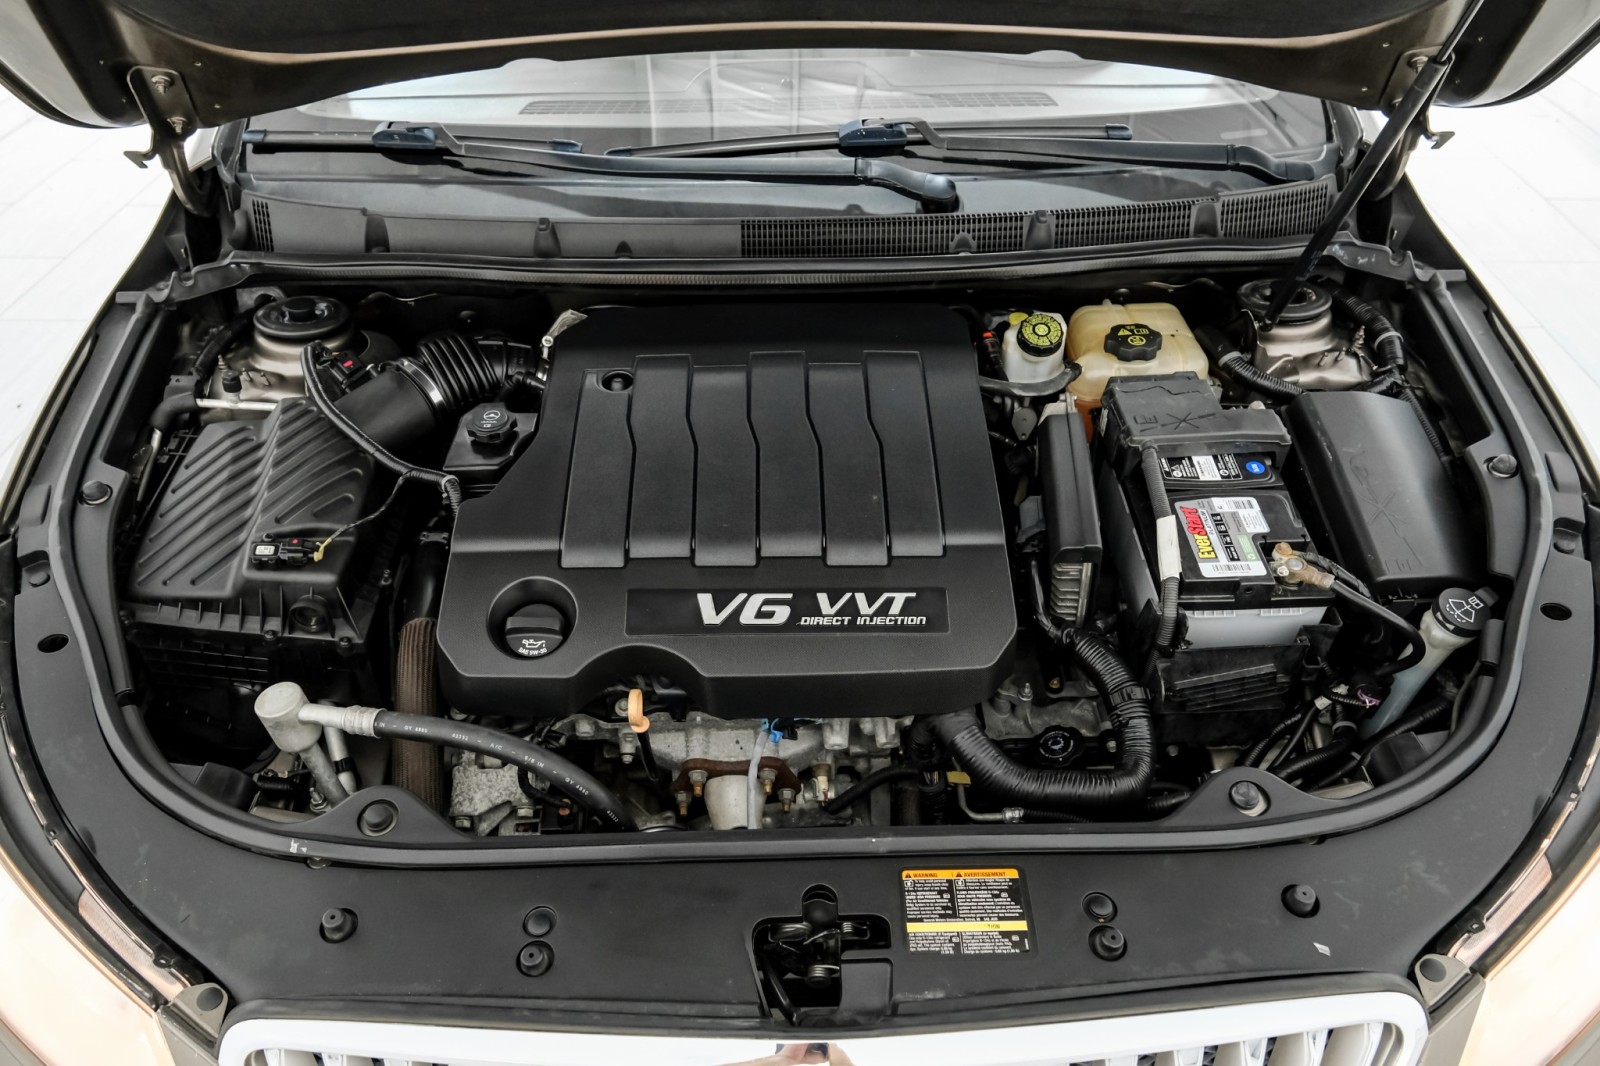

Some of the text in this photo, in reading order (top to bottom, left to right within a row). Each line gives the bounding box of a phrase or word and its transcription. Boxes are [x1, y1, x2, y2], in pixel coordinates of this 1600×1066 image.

[1200, 510, 1215, 534] PLATINUM
[1180, 506, 1217, 559] EverStart
[697, 592, 917, 626] V6 VVT
[800, 616, 927, 625] DIRECT INJECTION
[518, 646, 529, 655] SAE
[489, 742, 503, 751] A/C
